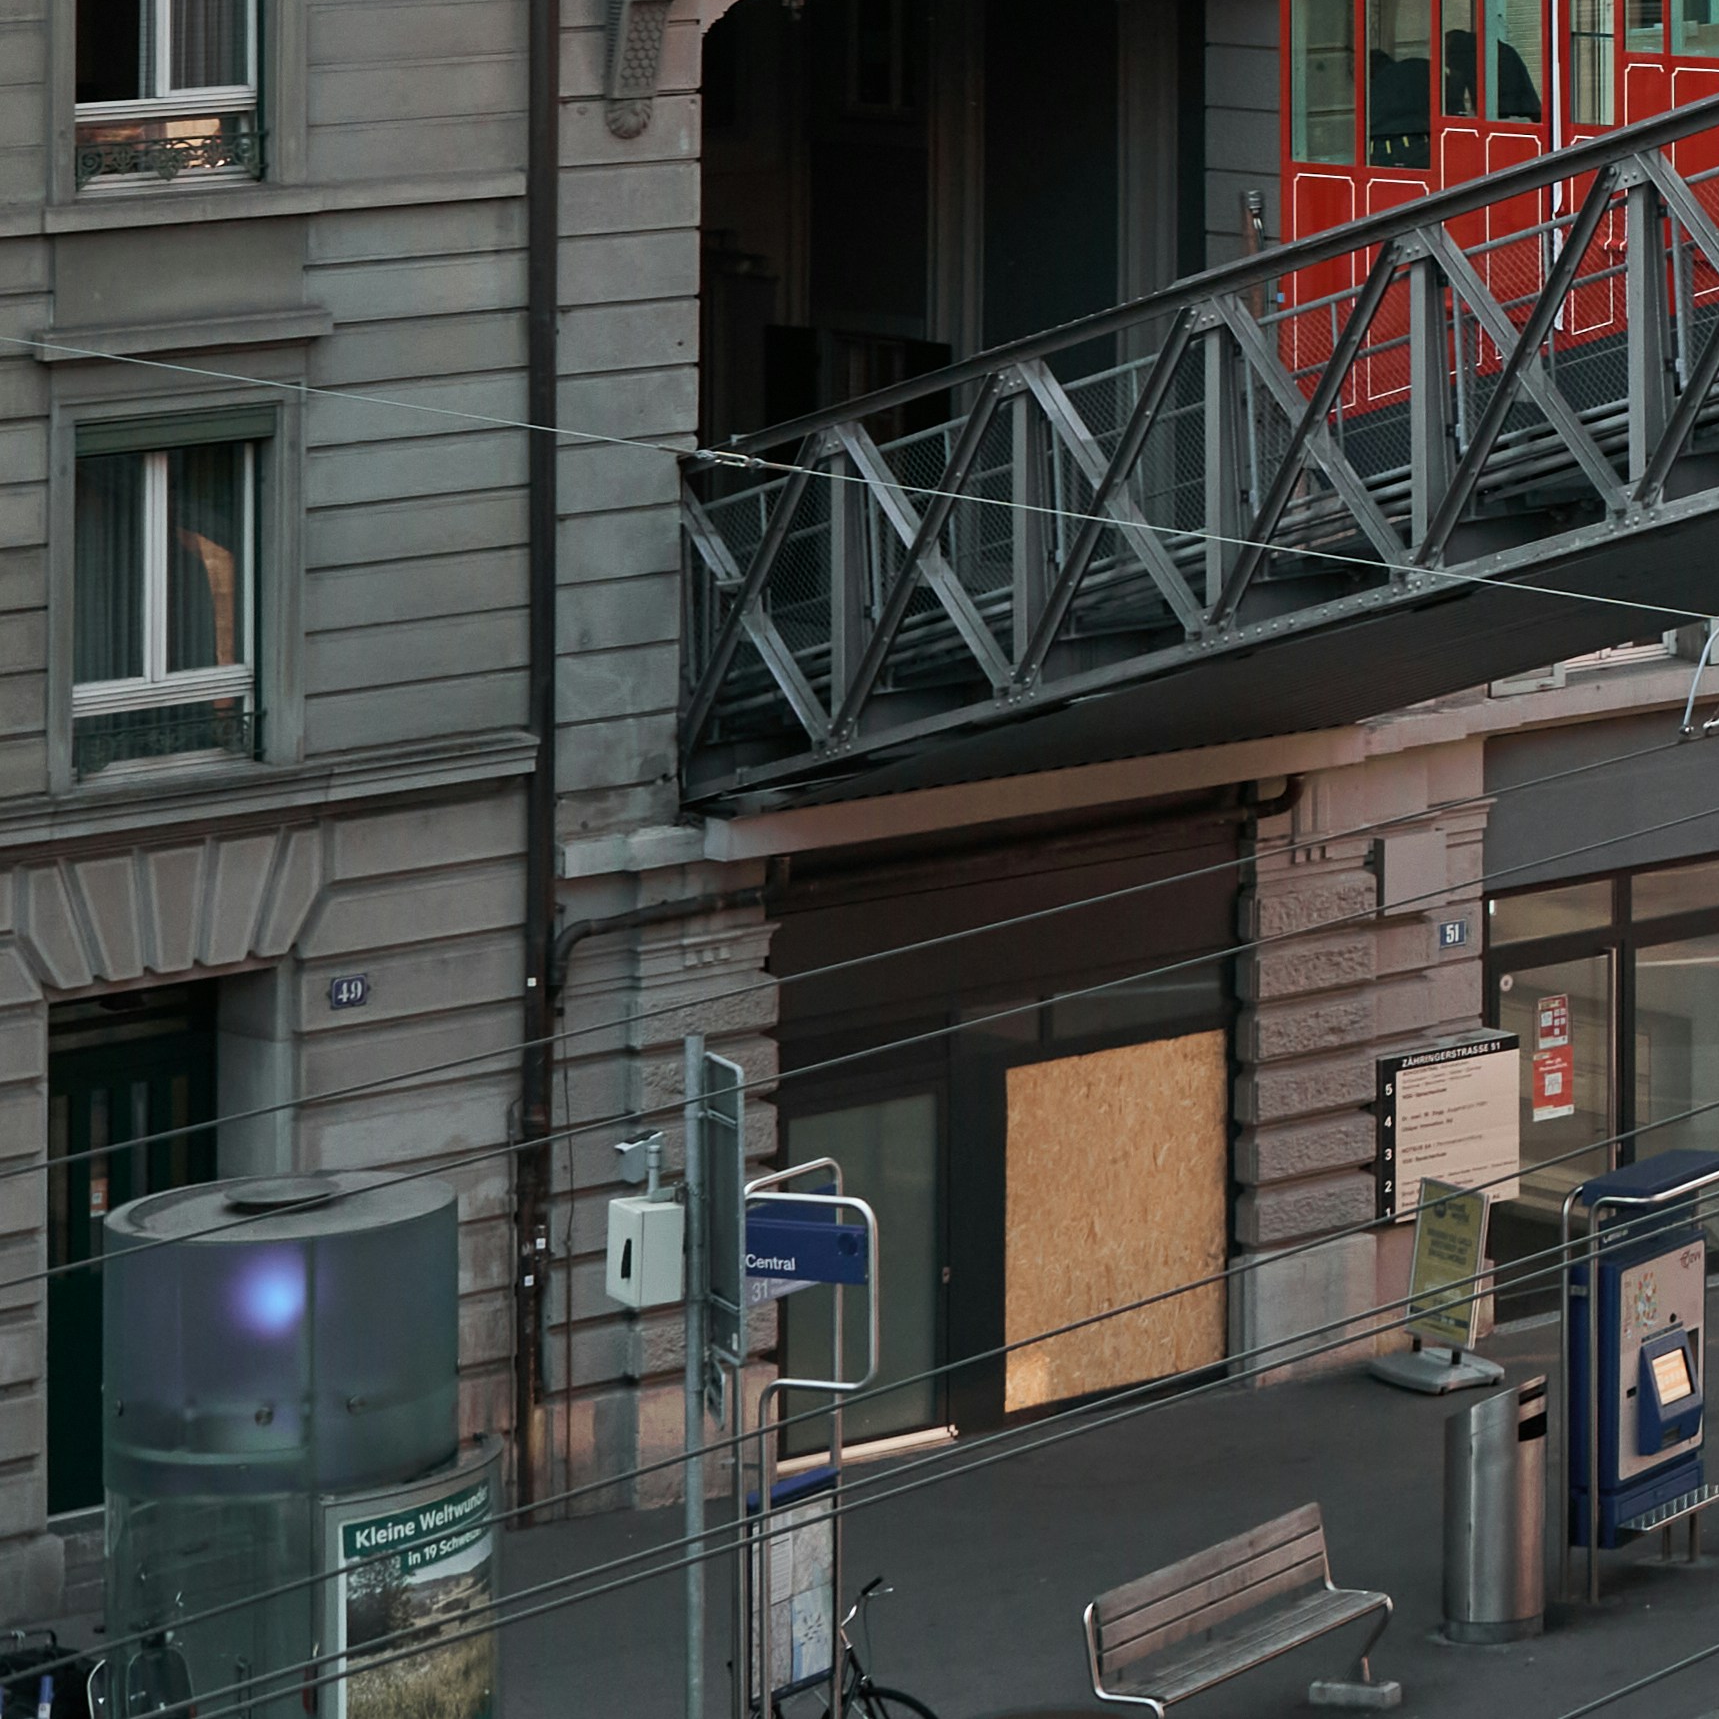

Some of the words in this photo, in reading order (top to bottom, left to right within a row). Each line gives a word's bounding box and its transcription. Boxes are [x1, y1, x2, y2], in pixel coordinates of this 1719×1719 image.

[1446, 923, 1460, 944] 51
[336, 980, 363, 1003] 49
[1401, 1043, 1489, 1068] ZÄHRINGERSTRASSE
[1384, 1084, 1393, 1096] 5
[1384, 1116, 1392, 1128] 4
[1384, 1148, 1393, 1160] 3
[1384, 1182, 1392, 1194] 2
[745, 1253, 796, 1271] Central
[751, 1279, 769, 1302] 31
[355, 1521, 416, 1549] Kleine
[408, 1551, 421, 1566] in
[423, 1544, 438, 1561] 19
